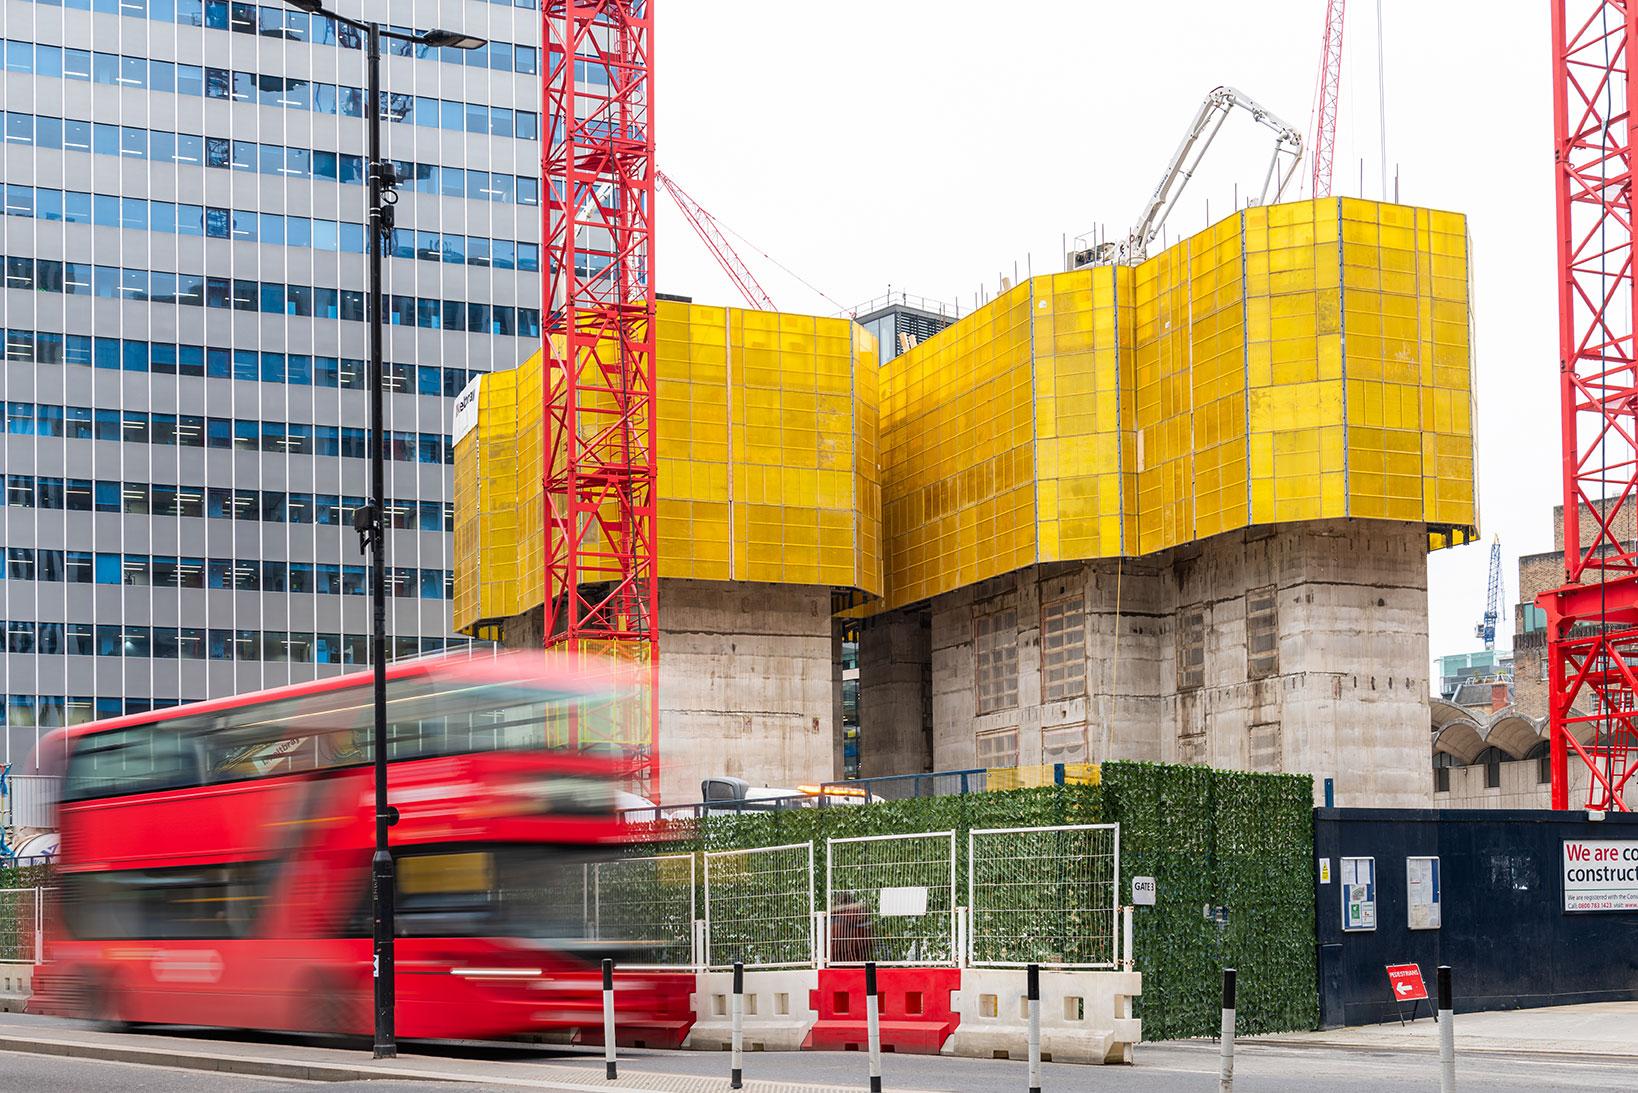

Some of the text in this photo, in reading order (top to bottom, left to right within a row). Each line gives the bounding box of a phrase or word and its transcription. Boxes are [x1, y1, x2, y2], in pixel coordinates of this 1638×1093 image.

[1566, 844, 1591, 861] We
[1594, 848, 1619, 861] are
[1134, 882, 1151, 891] GATE
[1389, 970, 1418, 978] PEDESTRIANS
